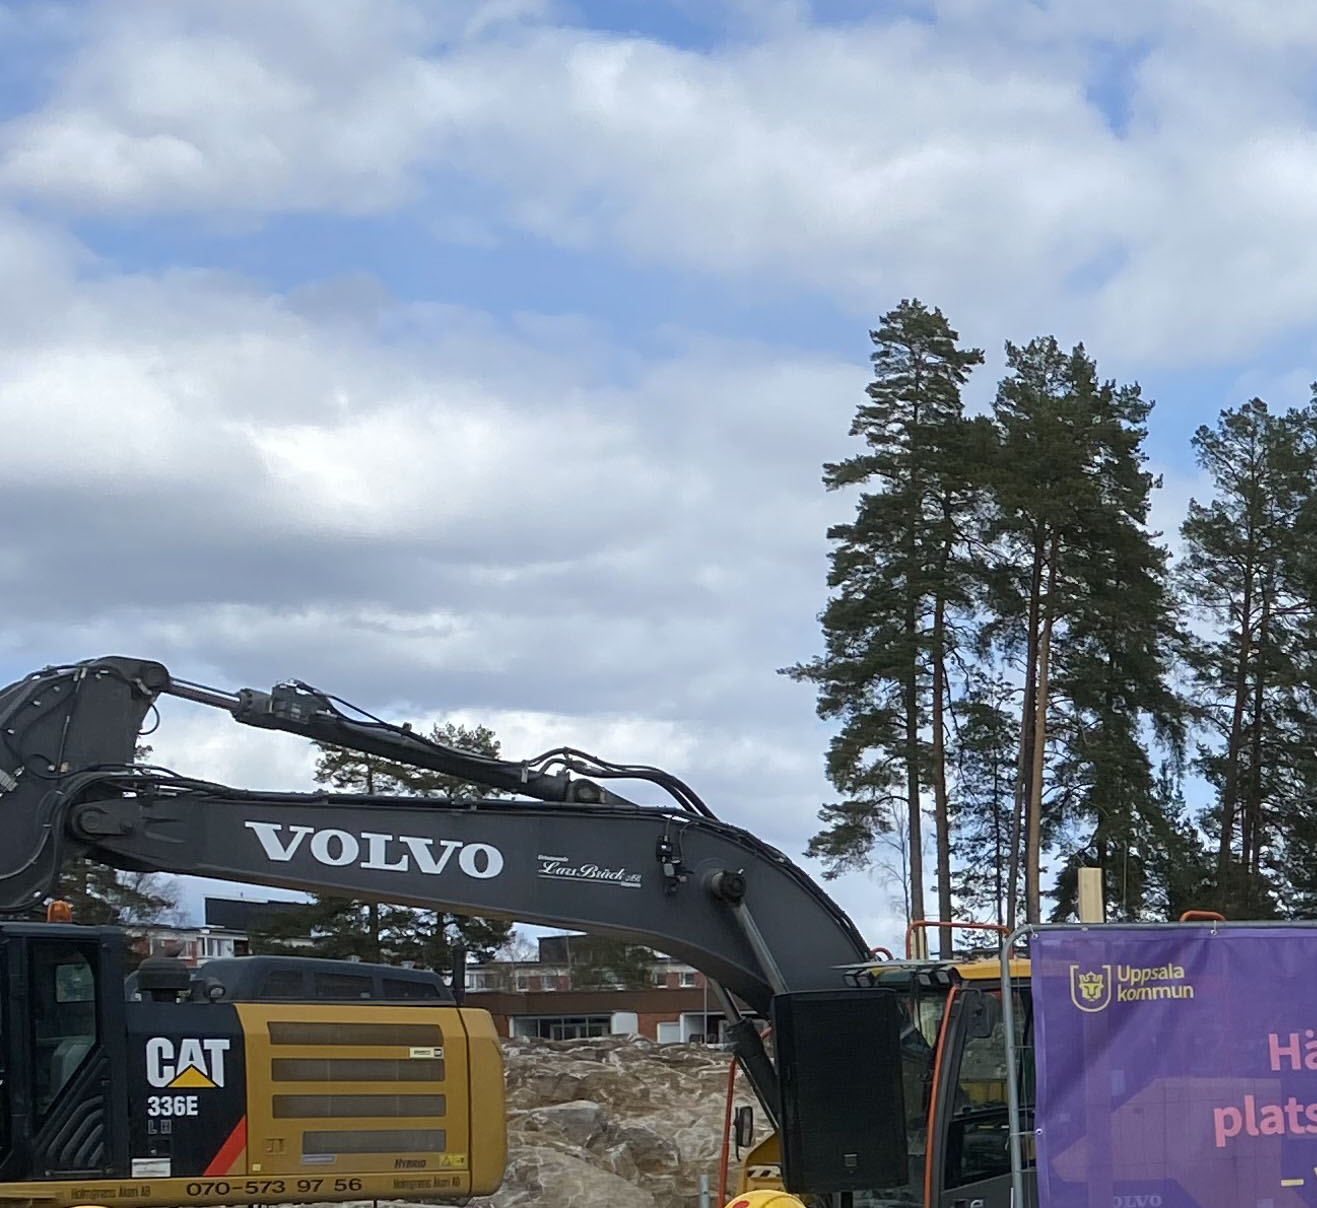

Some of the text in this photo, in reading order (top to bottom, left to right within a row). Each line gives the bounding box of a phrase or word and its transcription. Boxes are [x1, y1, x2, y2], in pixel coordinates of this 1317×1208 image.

[244, 821, 504, 878] VOLVO
[1117, 963, 1185, 986] Uppsala
[1117, 984, 1194, 1002] kommun
[146, 1037, 231, 1088] CAT
[147, 1095, 198, 1116] 336E
[187, 1178, 363, 1195] 070-573 97 56
